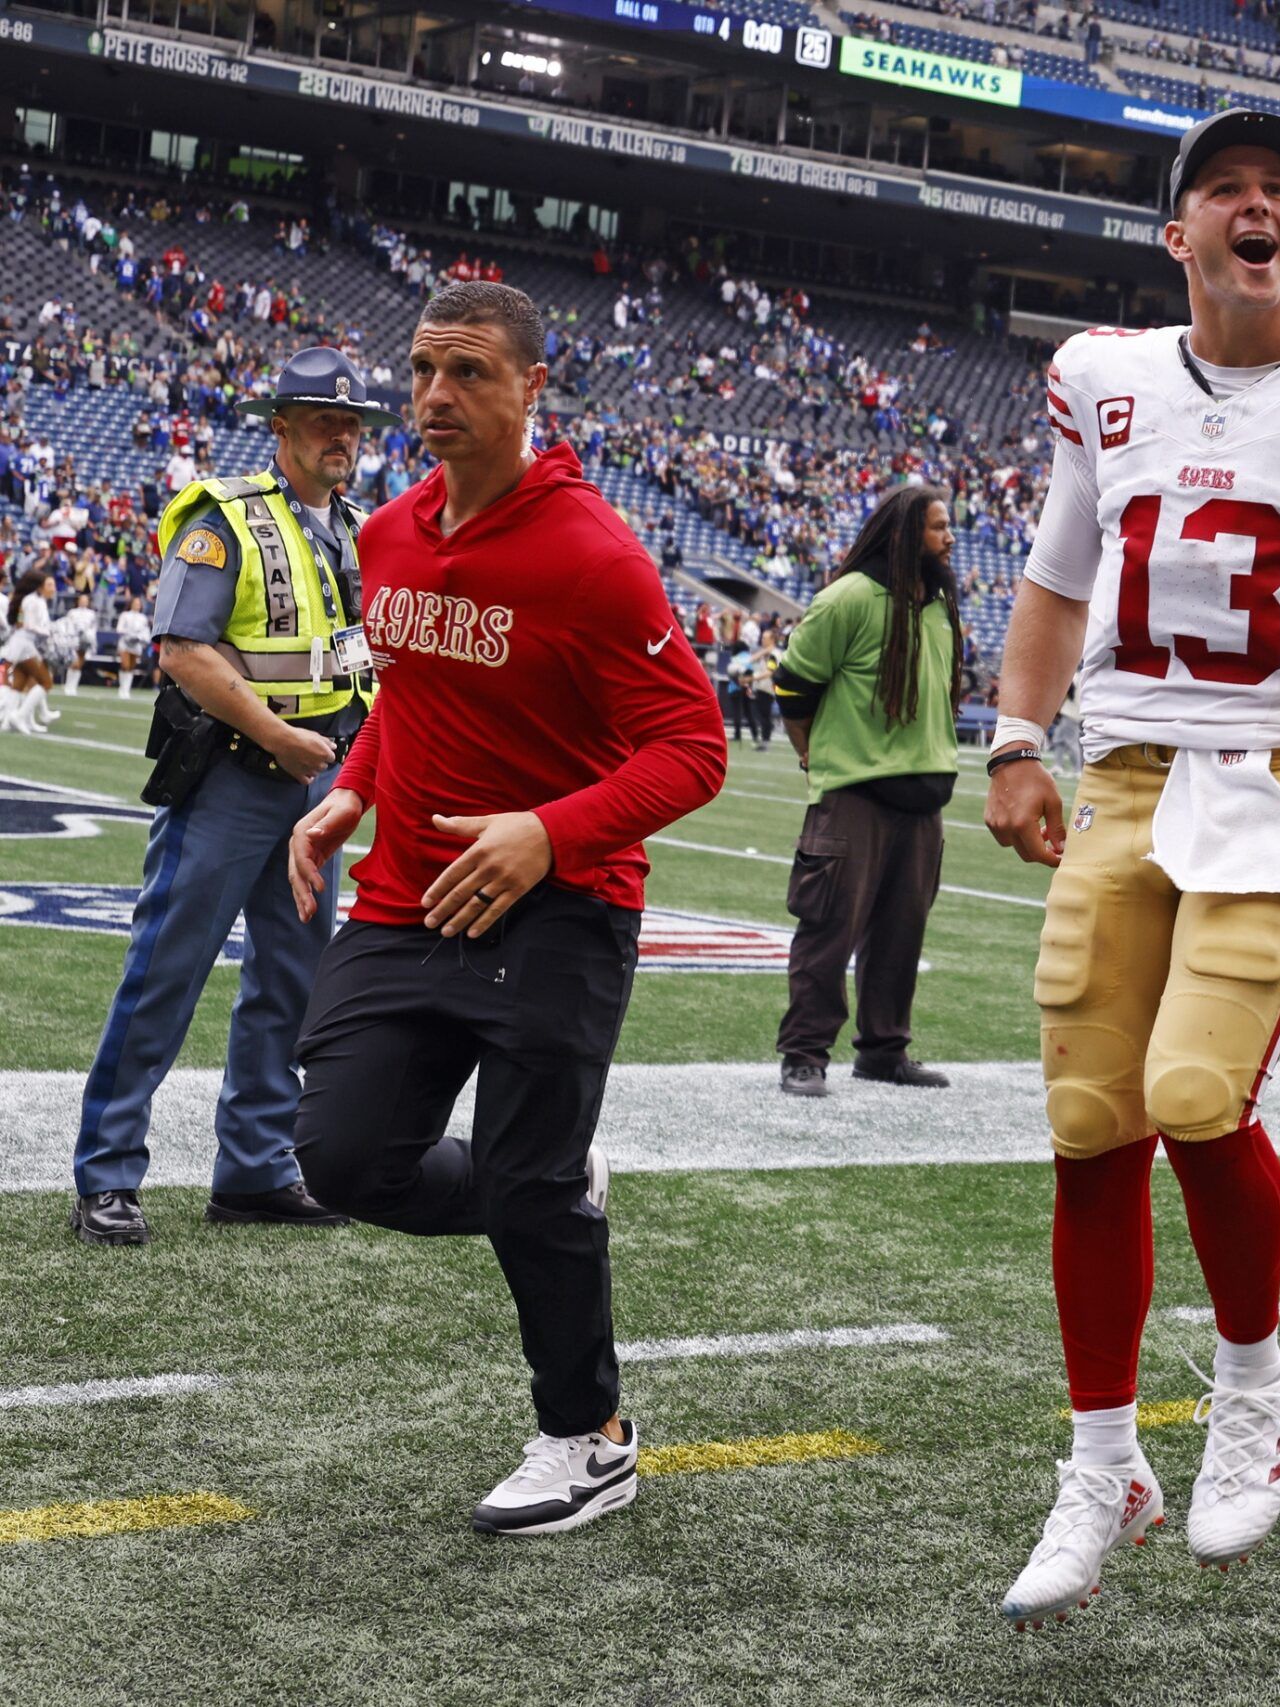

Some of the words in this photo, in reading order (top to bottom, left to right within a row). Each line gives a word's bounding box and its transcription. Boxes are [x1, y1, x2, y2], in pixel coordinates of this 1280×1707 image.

[615, 0, 640, 19] BALL
[642, 4, 658, 22] ON
[693, 14, 715, 34] QTR
[718, 17, 730, 42] 4
[0, 18, 33, 42] 6-86
[742, 19, 783, 54] 0:00
[802, 33, 826, 62] 25
[104, 33, 146, 64] PETE
[150, 43, 209, 76] GROSS
[862, 49, 1002, 94] SEAHAWKS
[299, 71, 328, 97] 28
[329, 76, 372, 106] CURT
[374, 86, 442, 119] WARNER
[1123, 105, 1203, 130] soundtransit.
[551, 119, 589, 146] PAUL
[591, 127, 606, 149] G.
[608, 129, 652, 158] ALLEN
[730, 151, 753, 175] 79
[754, 155, 798, 183] JACOB
[800, 164, 847, 191] GREEN
[918, 183, 943, 208] 45
[944, 190, 989, 216] KENNY
[989, 198, 1037, 225] EASLEY
[1102, 217, 1122, 238] 17
[1122, 221, 1154, 244] DAVE
[1099, 398, 1130, 435] C
[1204, 423, 1220, 436] NFL
[1177, 465, 1236, 491] 49ERS
[256, 525, 290, 634] STATE
[366, 586, 513, 668] 49ERS
[1221, 751, 1247, 767] NFL
[1120, 1487, 1153, 1529] adidas
